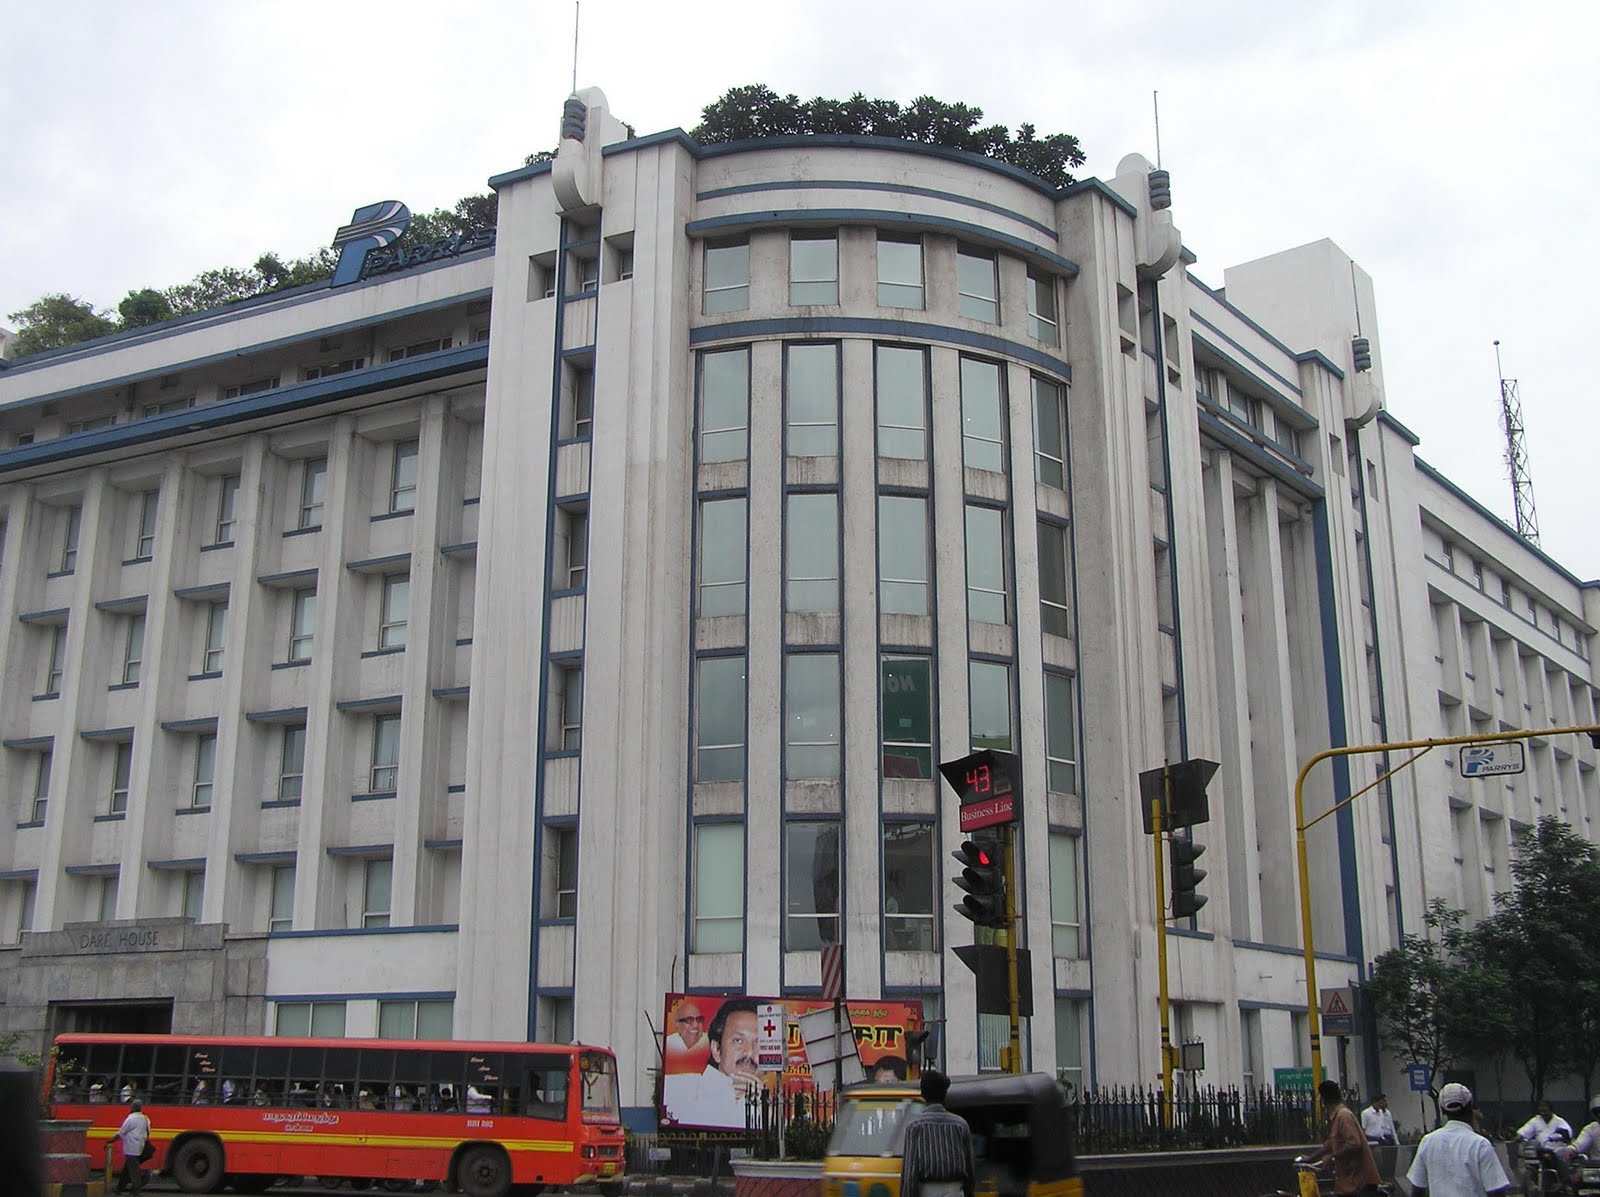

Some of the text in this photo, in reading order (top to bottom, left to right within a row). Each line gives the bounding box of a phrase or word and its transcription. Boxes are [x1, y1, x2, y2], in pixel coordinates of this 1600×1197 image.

[1483, 763, 1519, 772] PARRYS
[965, 764, 991, 792] 43
[961, 801, 1013, 822] Business Line
[80, 931, 159, 949] DARE HOUSE
